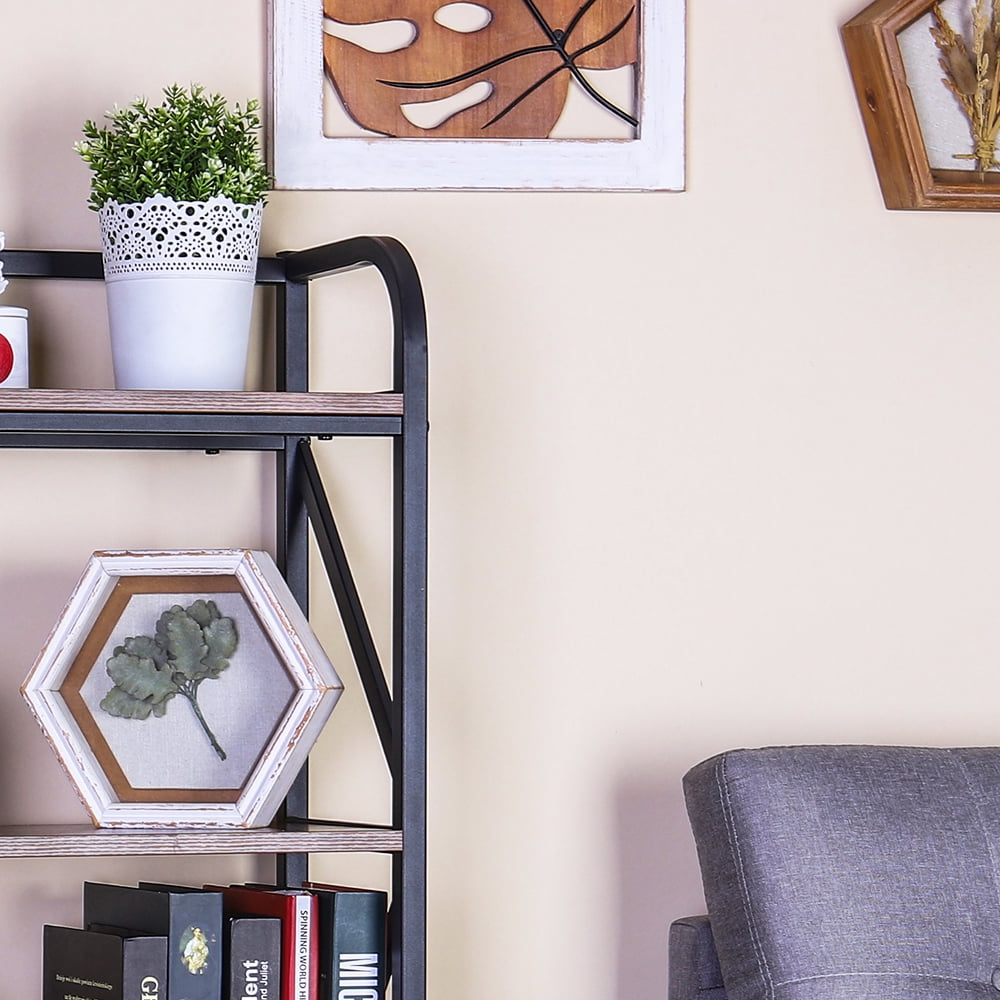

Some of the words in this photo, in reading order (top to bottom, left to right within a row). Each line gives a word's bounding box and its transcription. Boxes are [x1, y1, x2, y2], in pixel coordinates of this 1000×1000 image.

[299, 910, 309, 954] SPINNING
[259, 961, 269, 986] Juliet
[298, 955, 307, 989] WORLD
